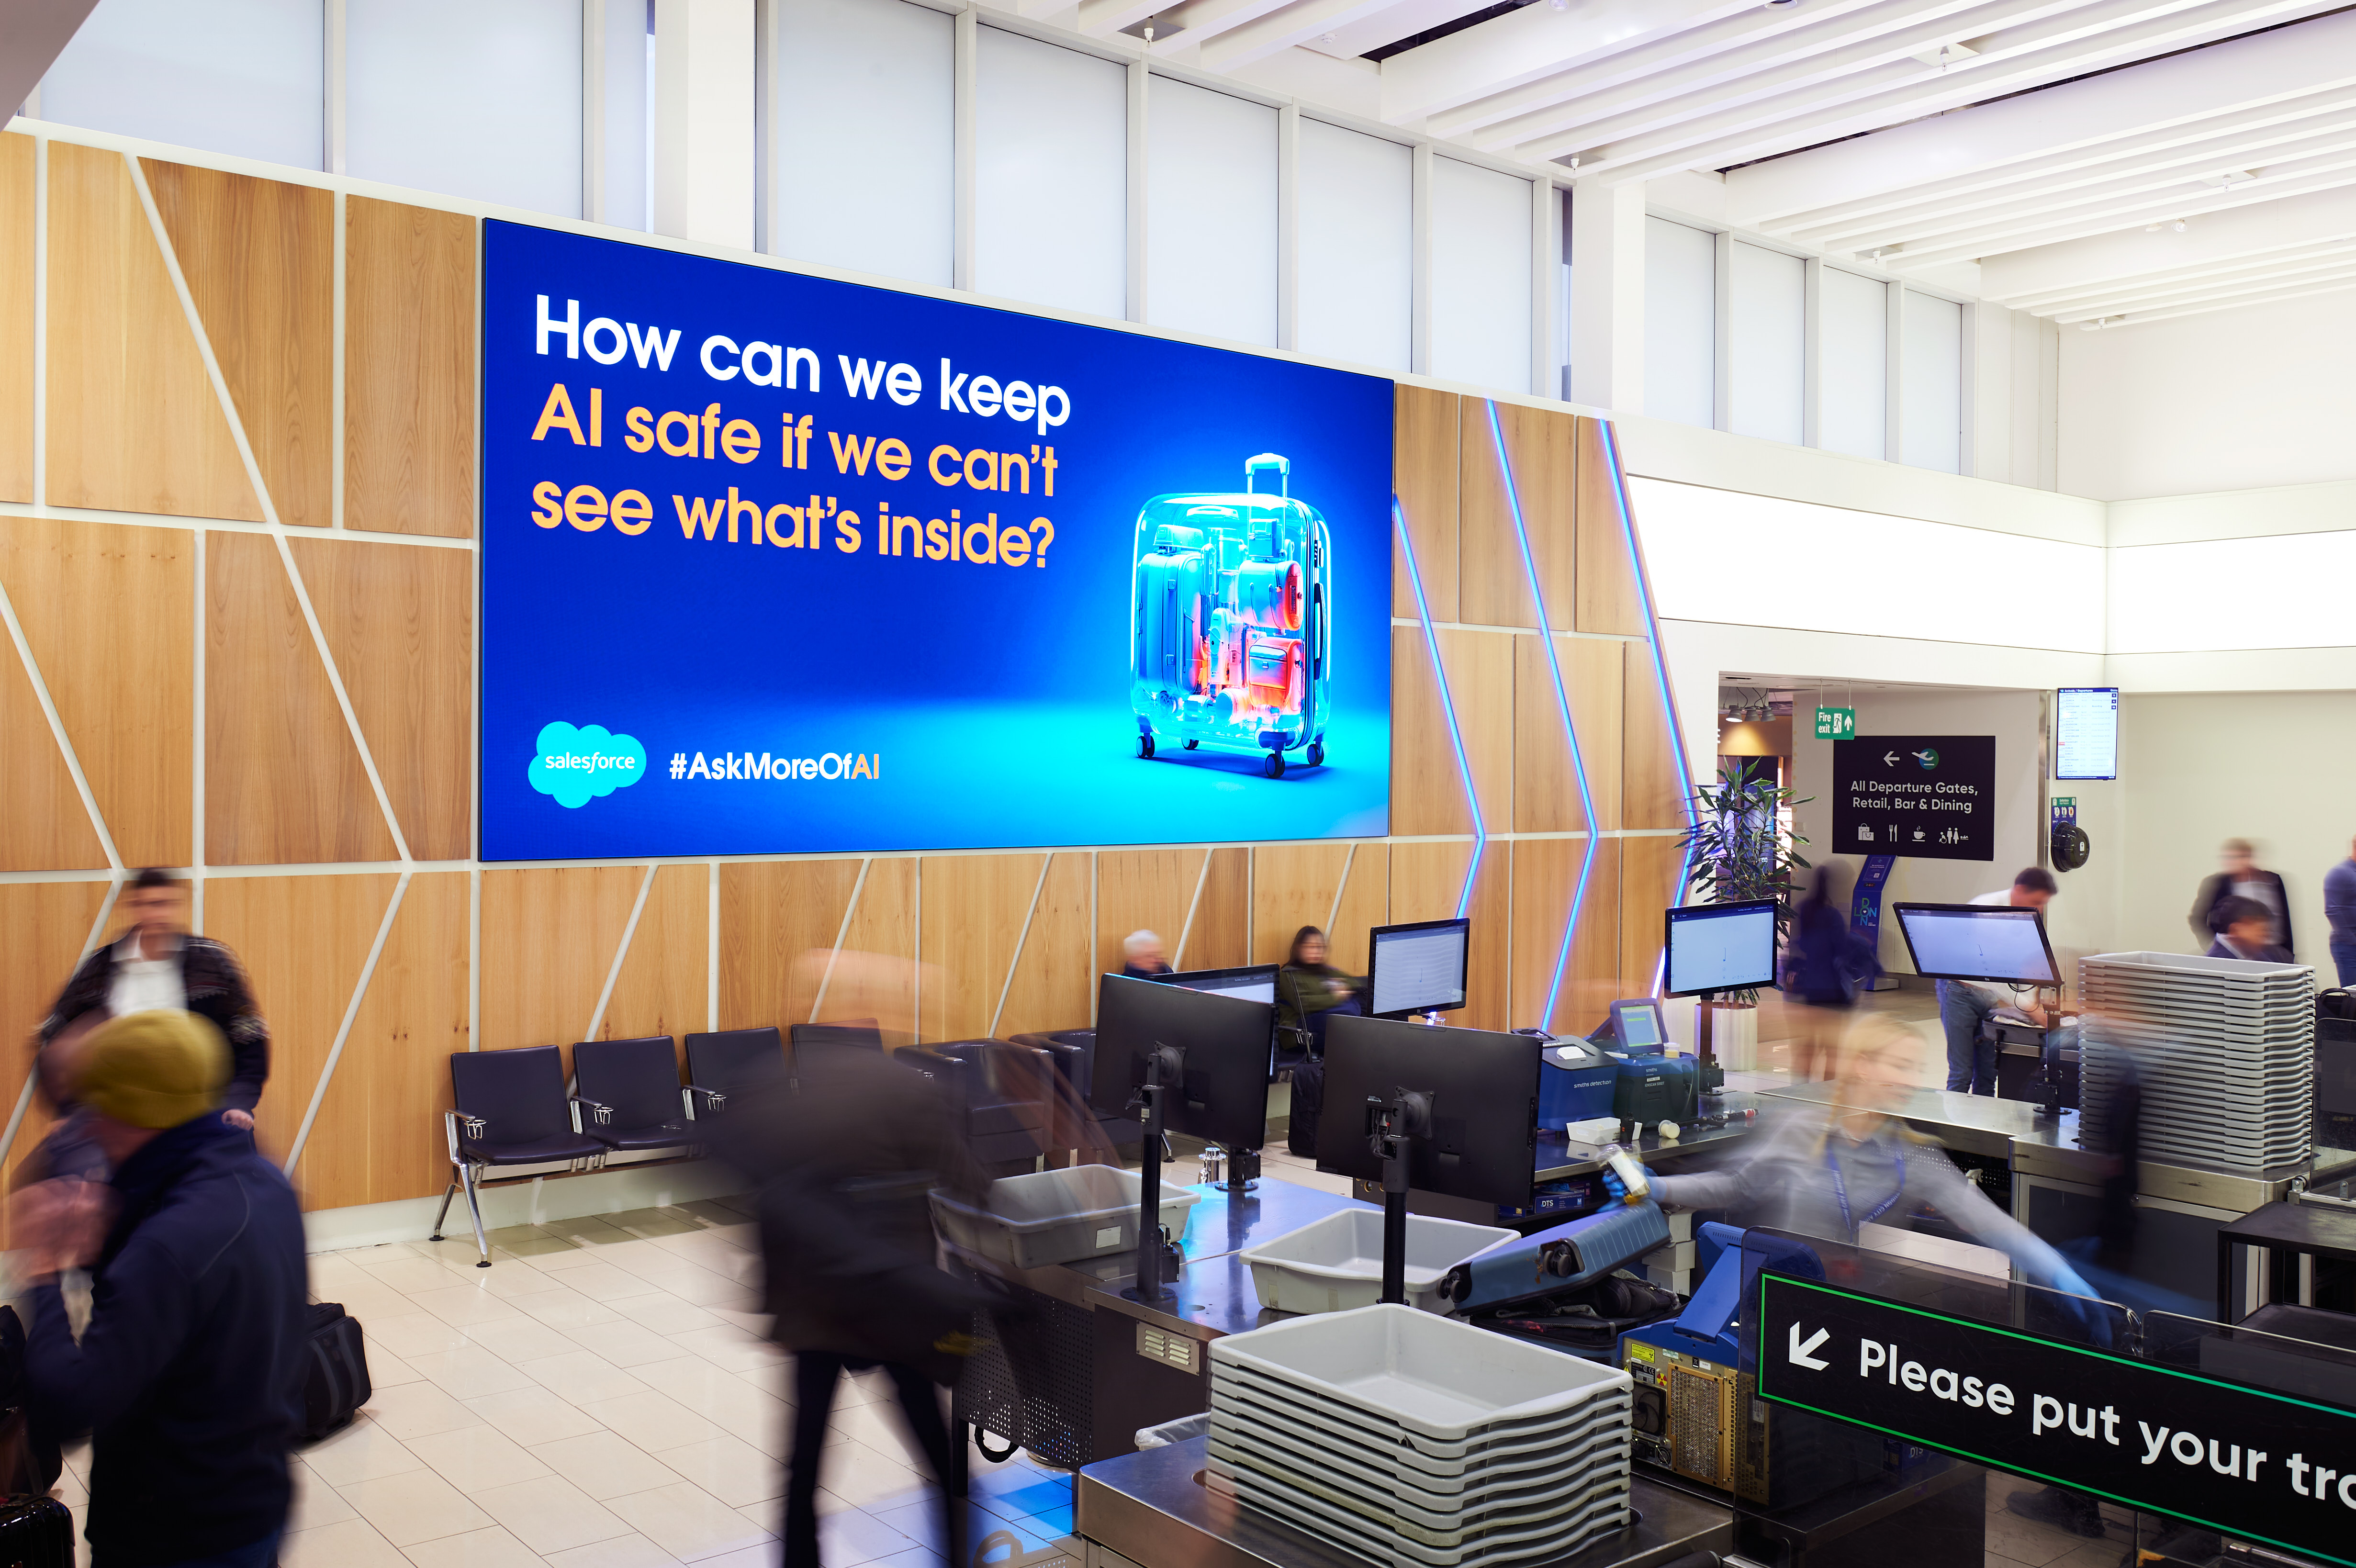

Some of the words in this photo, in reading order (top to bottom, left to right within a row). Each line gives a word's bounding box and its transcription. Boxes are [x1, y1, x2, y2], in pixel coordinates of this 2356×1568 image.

[537, 294, 681, 371] How
[700, 336, 819, 392] can
[838, 355, 921, 405] we
[941, 358, 1070, 436] keep
[531, 383, 602, 447] AI
[625, 403, 761, 464] safe
[783, 413, 813, 470] if
[828, 432, 911, 481] we
[929, 445, 1058, 496] can't
[531, 481, 653, 536] see
[672, 487, 861, 553] what's
[879, 502, 1054, 568] inside?
[1818, 712, 1831, 722] Fire
[1818, 724, 1830, 733] exit
[546, 751, 635, 774] salesforce
[670, 752, 879, 780] #AskMoreOfAI
[1851, 781, 1865, 791] All
[1870, 781, 1932, 795] Departure
[1936, 783, 1978, 795] Gates,
[1853, 797, 1891, 810] Retail,
[1896, 798, 1915, 809] Bar
[1919, 799, 1928, 809] &
[1932, 799, 1972, 814] Dining
[1861, 1339, 2015, 1415] Please
[2033, 1394, 2120, 1445] put
[2138, 1421, 2267, 1482] your
